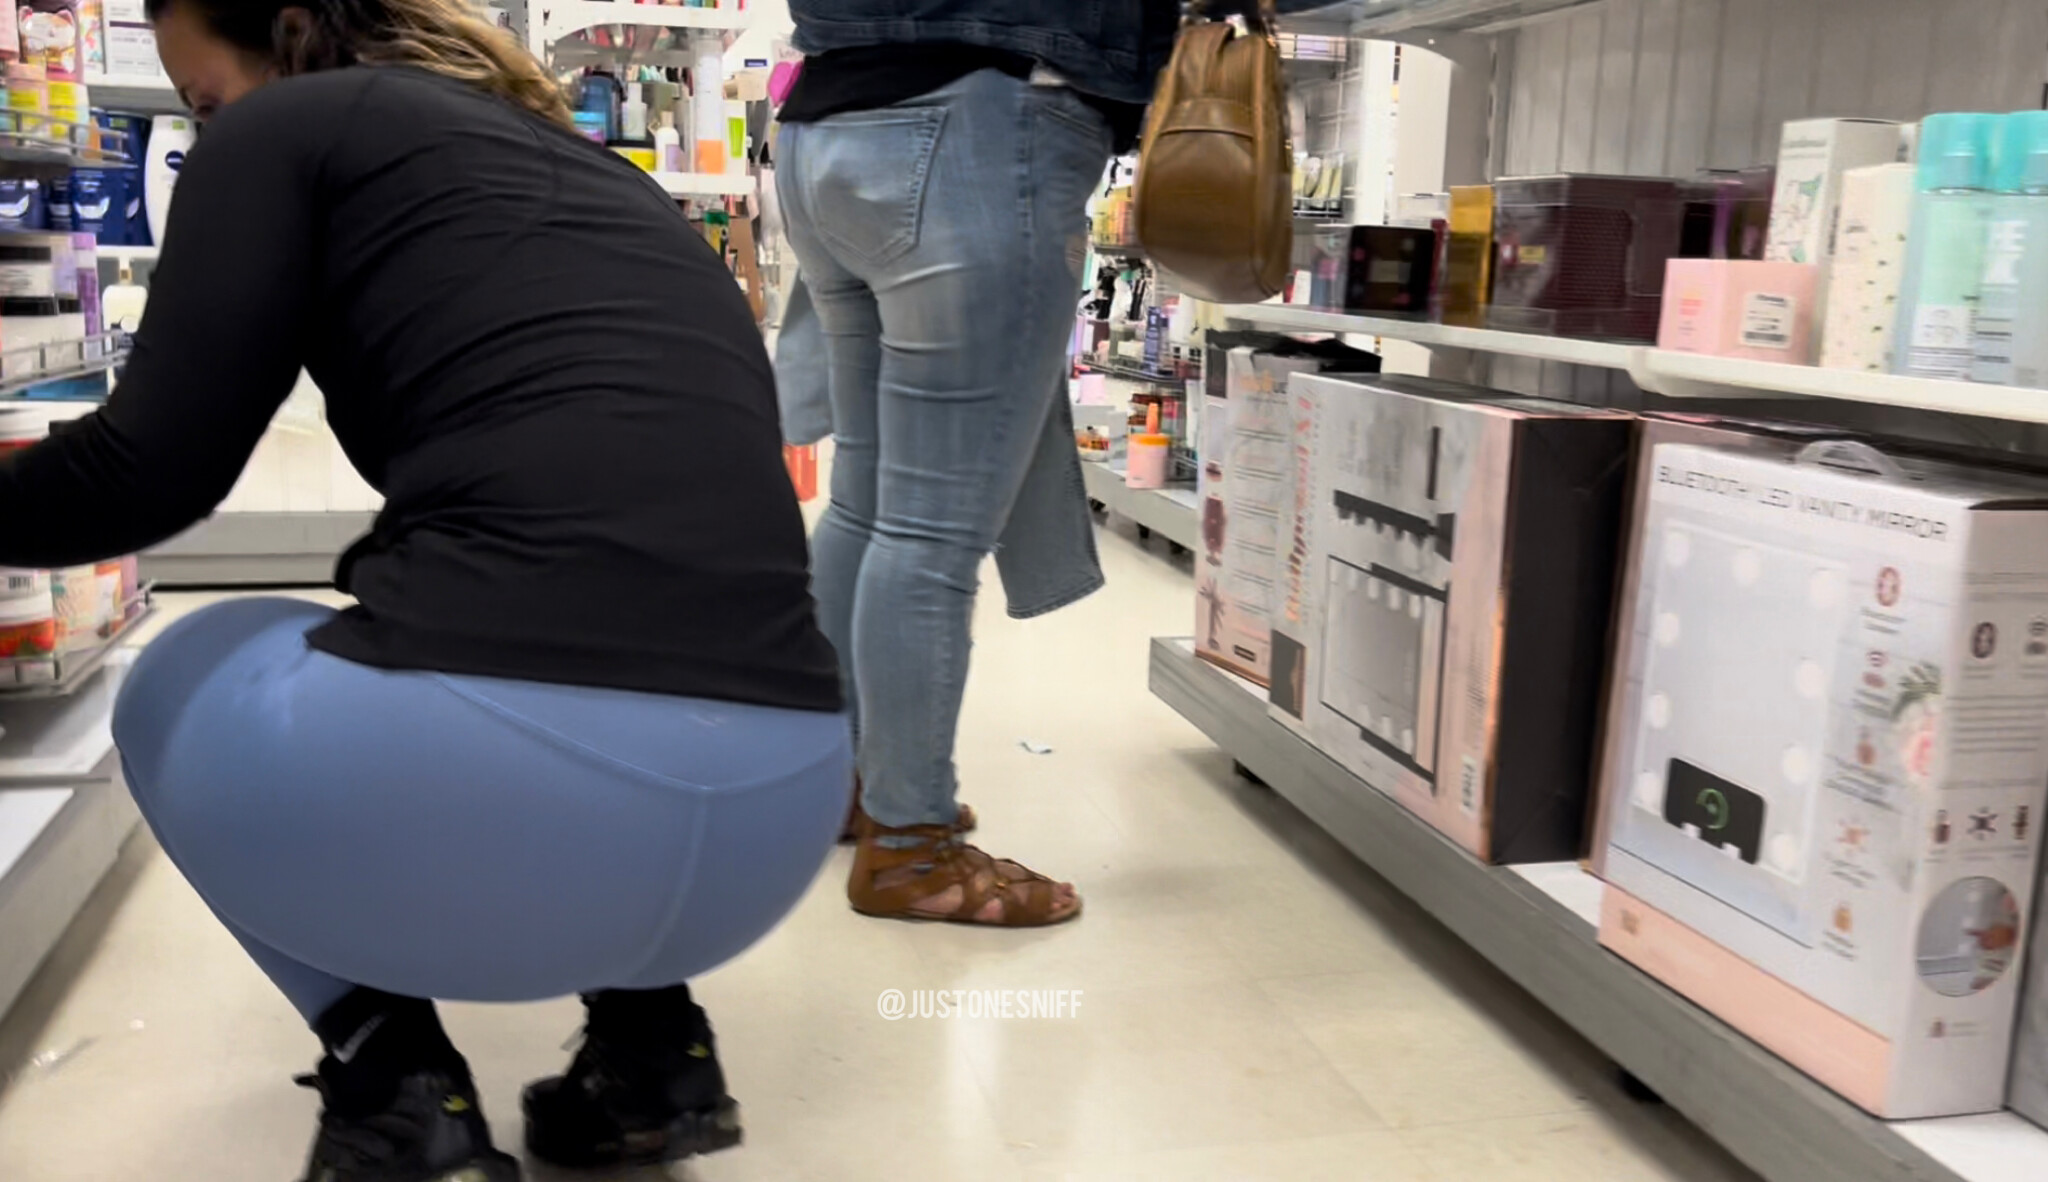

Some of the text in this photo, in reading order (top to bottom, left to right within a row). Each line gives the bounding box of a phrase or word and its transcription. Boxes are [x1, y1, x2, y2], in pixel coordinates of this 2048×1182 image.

[1658, 465, 1948, 541] BLUETOOTH LED VANITY MIRROR
